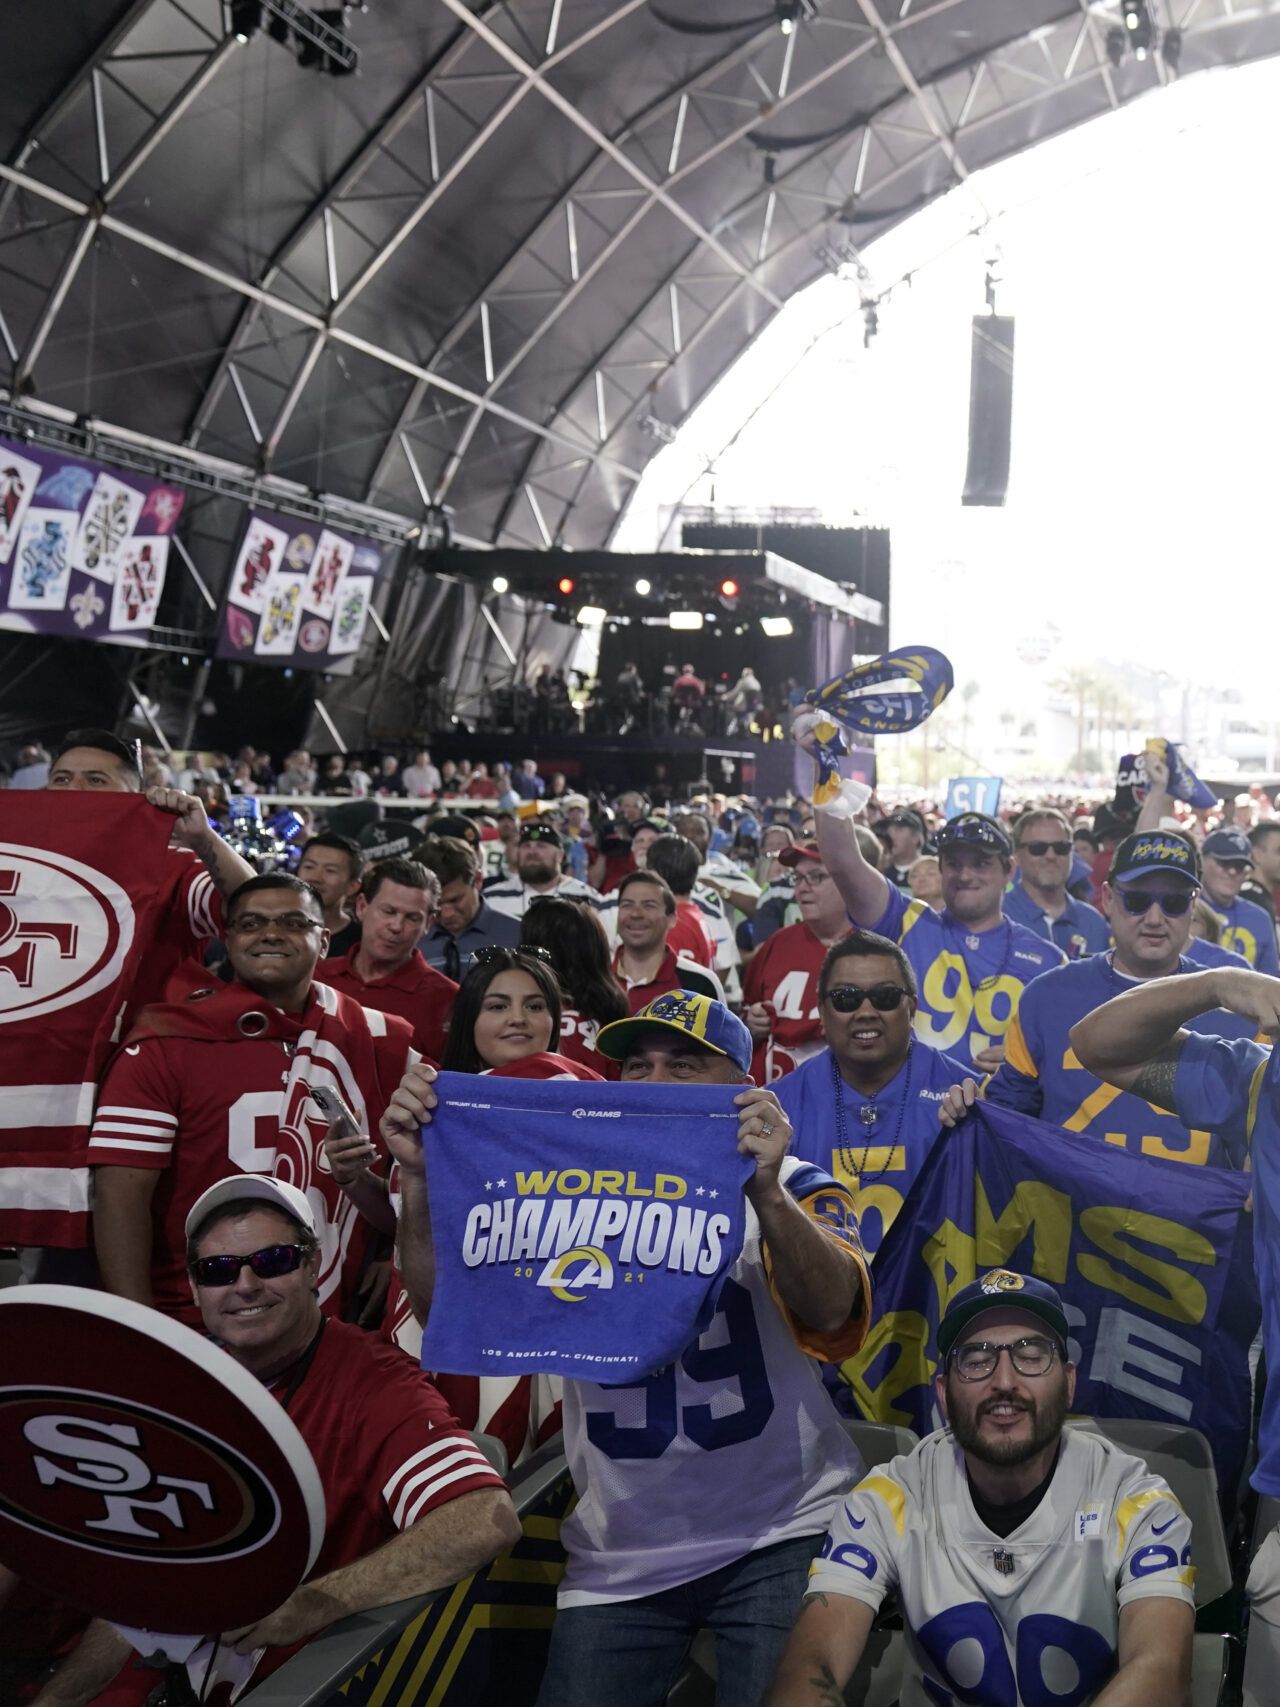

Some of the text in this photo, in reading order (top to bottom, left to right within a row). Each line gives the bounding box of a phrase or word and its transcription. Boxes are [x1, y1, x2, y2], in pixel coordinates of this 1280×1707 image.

[1117, 771, 1149, 787] CAR
[919, 1088, 951, 1101] RAM
[587, 1110, 622, 1118] RAMS
[514, 1168, 687, 1200] WORLD
[462, 1198, 731, 1276] CHAMPIONS
[514, 1267, 533, 1278] 20
[624, 1272, 645, 1284] 21
[482, 1349, 502, 1357] LOS
[574, 1353, 639, 1363] CINCINNATI
[22, 1414, 215, 1540] SF
